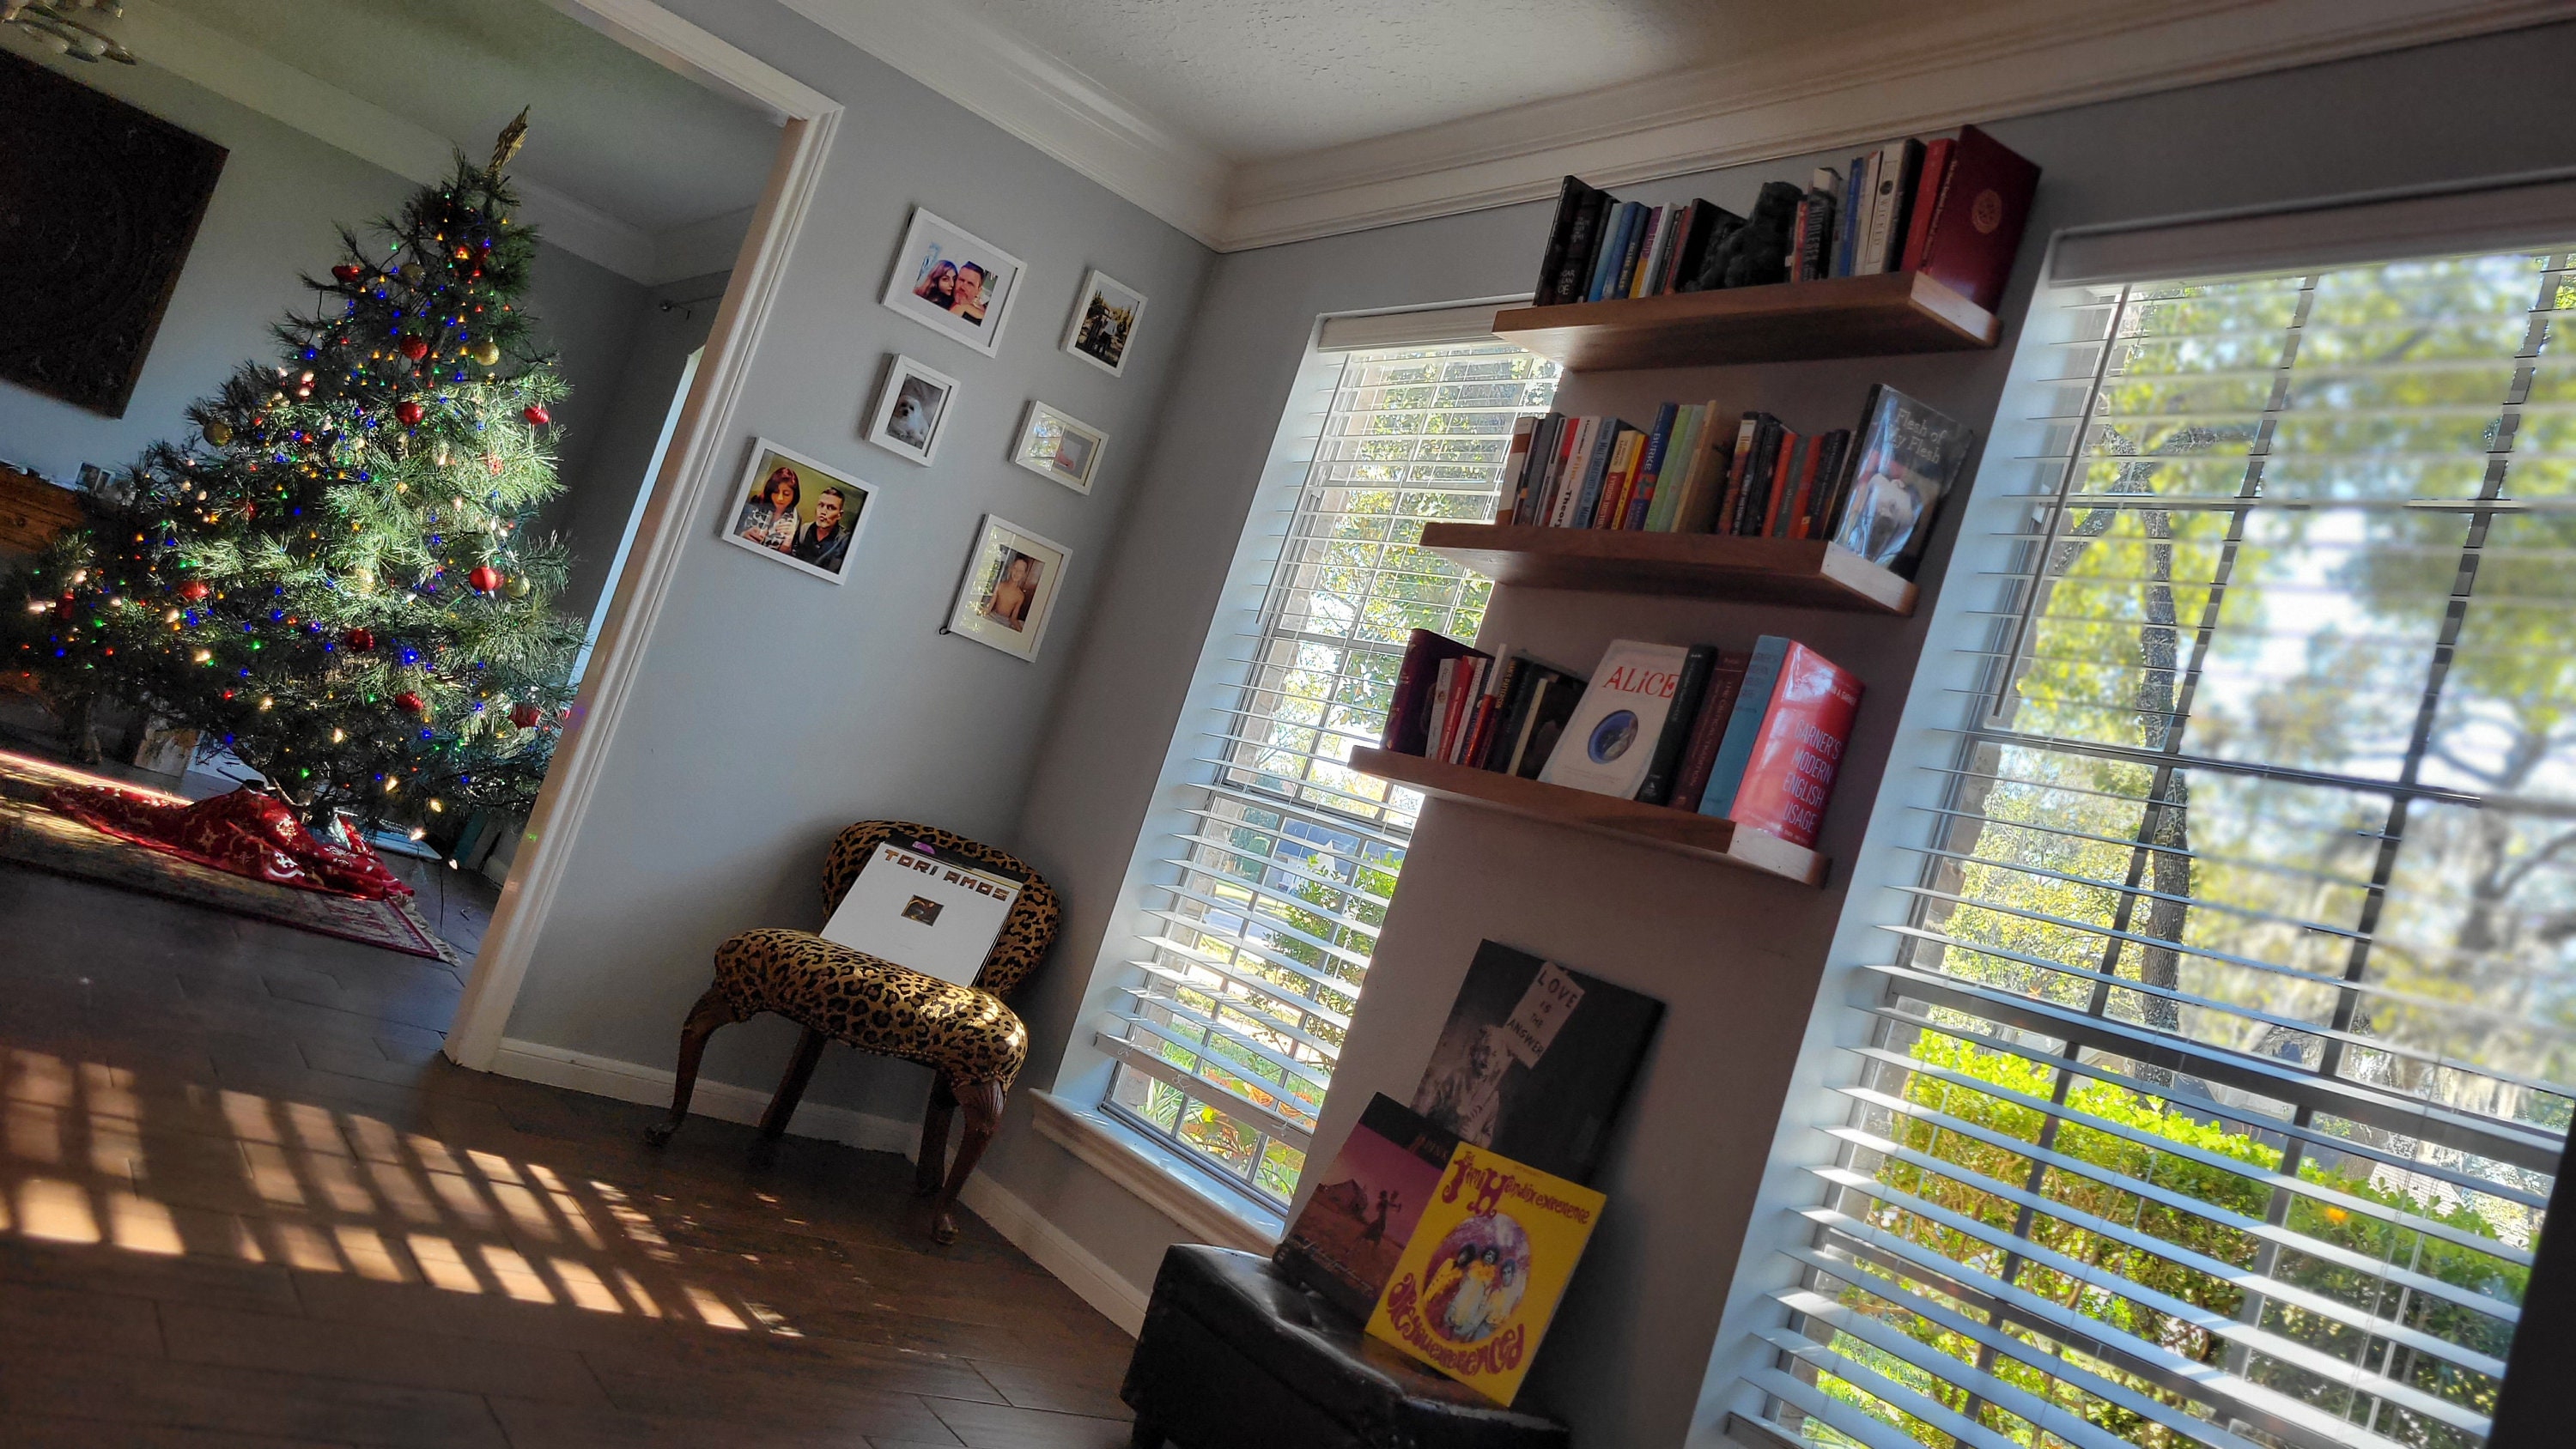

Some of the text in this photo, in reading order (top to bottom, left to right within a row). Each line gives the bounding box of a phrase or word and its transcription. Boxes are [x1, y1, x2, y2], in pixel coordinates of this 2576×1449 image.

[1806, 206, 1824, 259] MIDDLESEX
[1874, 198, 1889, 246] WICKED
[1895, 408, 1947, 444] Flesh of
[1569, 452, 1582, 482] Film
[1644, 432, 1660, 471] BURKE
[1908, 436, 1940, 464] Flesh
[1555, 488, 1571, 530] Theory
[1494, 676, 1510, 710] PATTERSON
[1707, 697, 1725, 738] CRITICAL
[1794, 720, 1843, 760] GARNER'S
[1689, 737, 1710, 787] TRADITION
[1791, 748, 1833, 785] MODERN
[1783, 773, 1826, 809] ENGLISH
[1782, 801, 1817, 834] USAGE
[884, 848, 1012, 901] TORI AMOS
[1538, 970, 1577, 1008] LOVE
[1540, 1001, 1552, 1013] IS
[1507, 1018, 1544, 1057] ANSWER
[1531, 1013, 1544, 1028] THE
